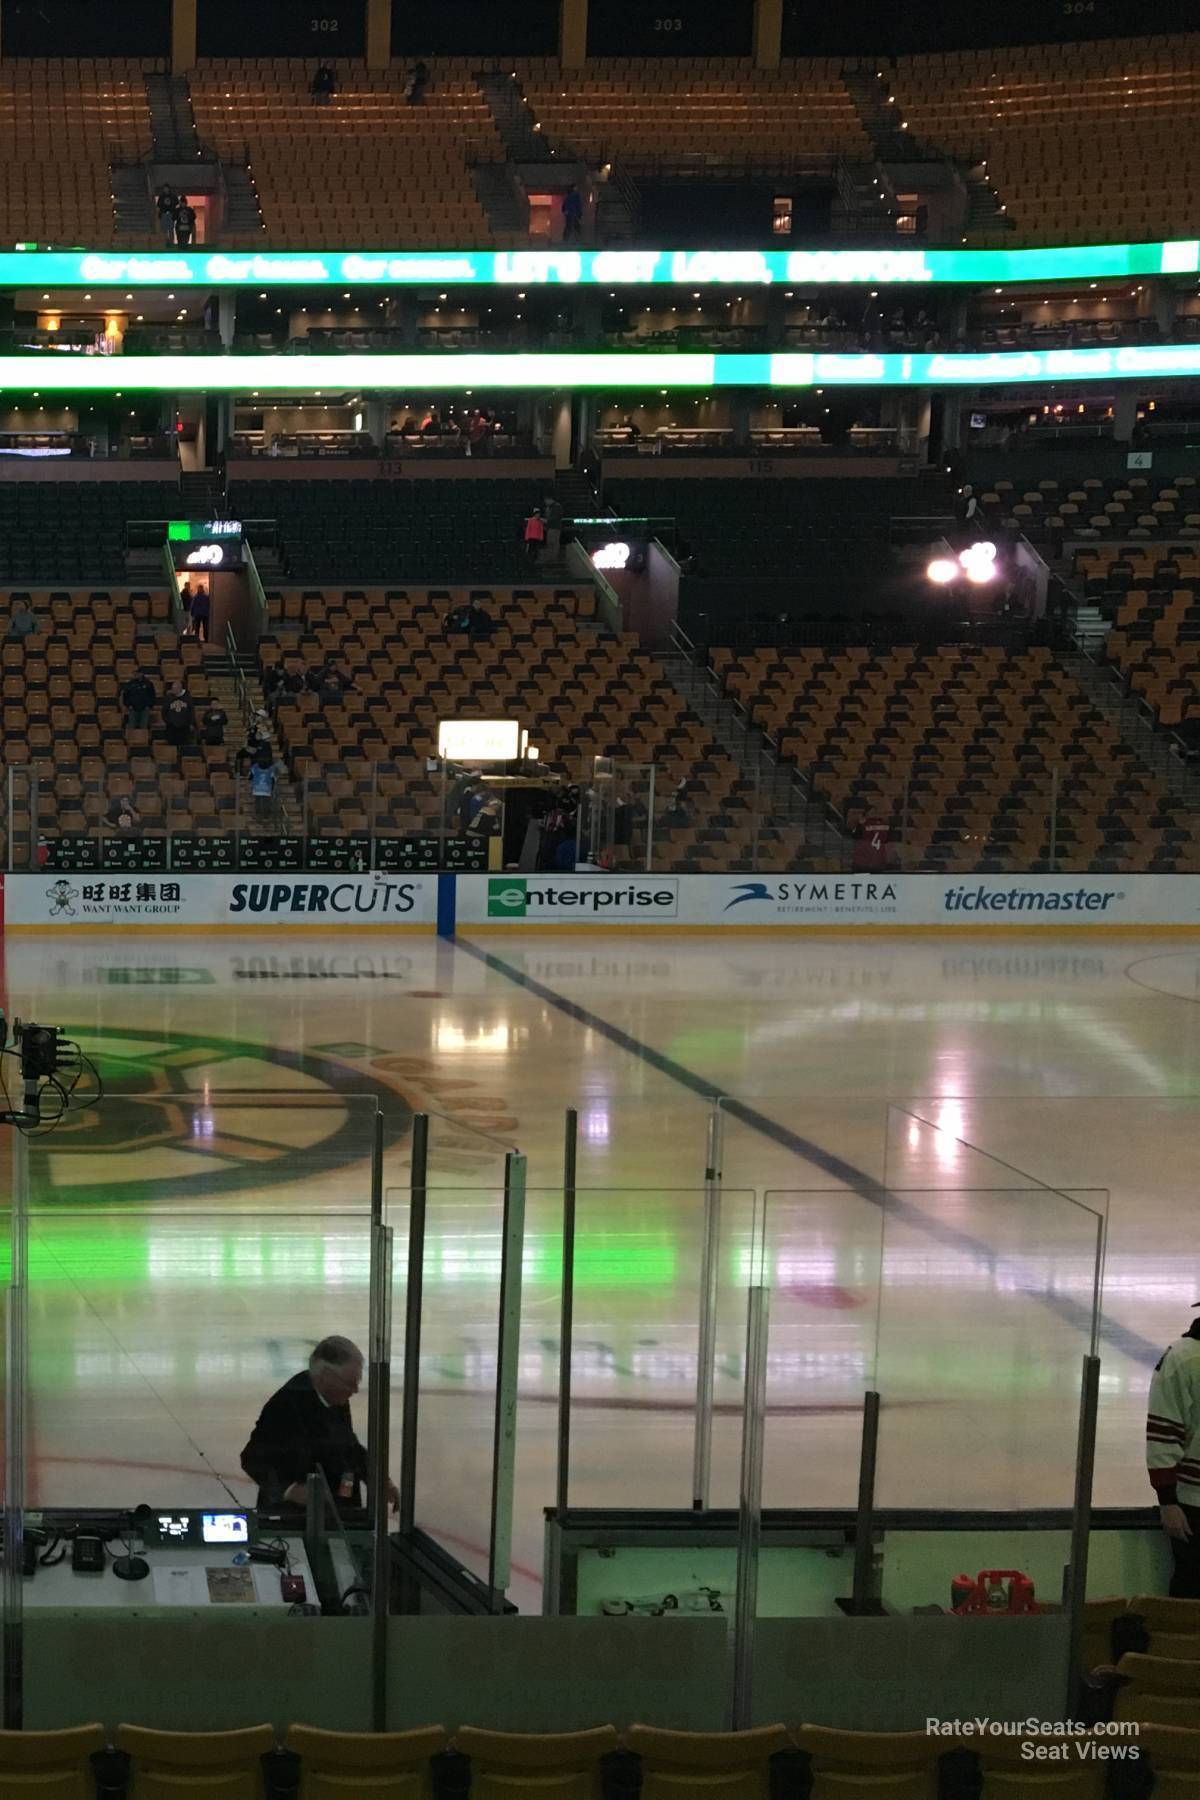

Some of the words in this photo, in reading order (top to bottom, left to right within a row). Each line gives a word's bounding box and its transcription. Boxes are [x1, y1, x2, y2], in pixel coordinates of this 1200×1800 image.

[1063, 2, 1096, 14] 304
[311, 19, 339, 31] 302
[654, 19, 683, 31] 303
[1133, 453, 1145, 467] 4
[871, 832, 881, 850] 4
[82, 883, 180, 902] 旺旺集团
[229, 883, 416, 912] SUPERCUTS
[500, 886, 675, 911] enterprise
[778, 883, 897, 900] SYMETRA
[944, 886, 1116, 911] ticketmaster
[82, 904, 112, 913] WANT
[114, 904, 143, 913] WANT
[144, 904, 180, 913] GROUP
